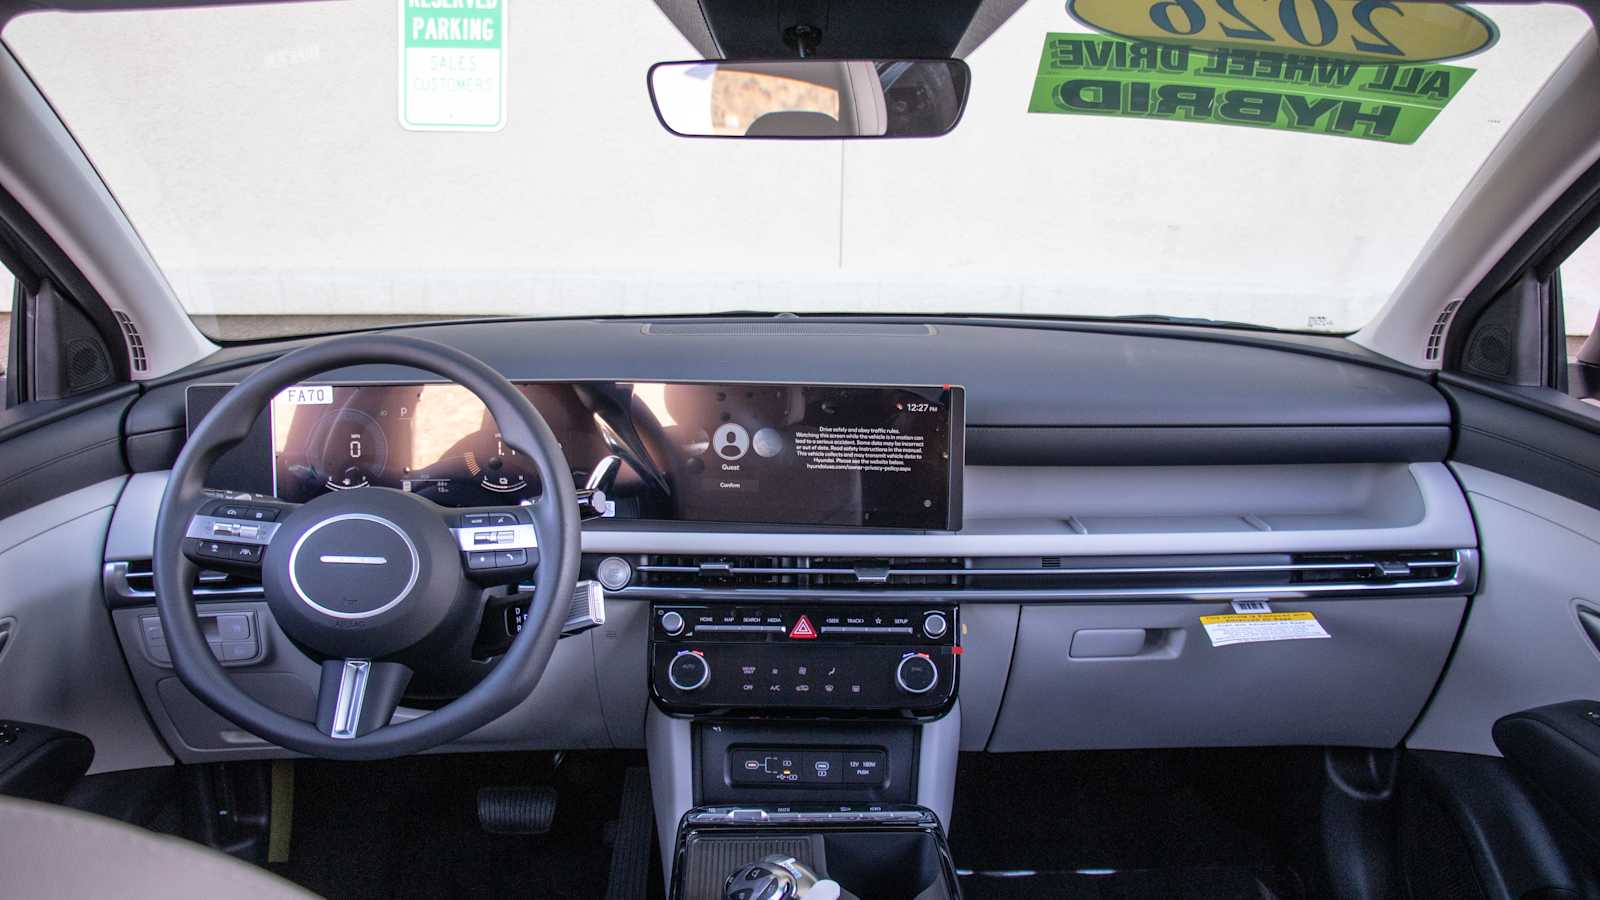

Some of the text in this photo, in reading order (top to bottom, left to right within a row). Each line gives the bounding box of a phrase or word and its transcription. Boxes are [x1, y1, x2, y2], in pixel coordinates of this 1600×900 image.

[411, 17, 495, 41] PARKING
[430, 55, 477, 72] SALES
[413, 77, 494, 93] CUSTOMERS
[288, 389, 324, 402] FA70
[400, 407, 408, 417] P
[906, 403, 929, 412] 12:27
[350, 441, 361, 458] 0
[721, 463, 741, 471] Guest
[719, 481, 741, 489] Confirm
[516, 616, 522, 624] N
